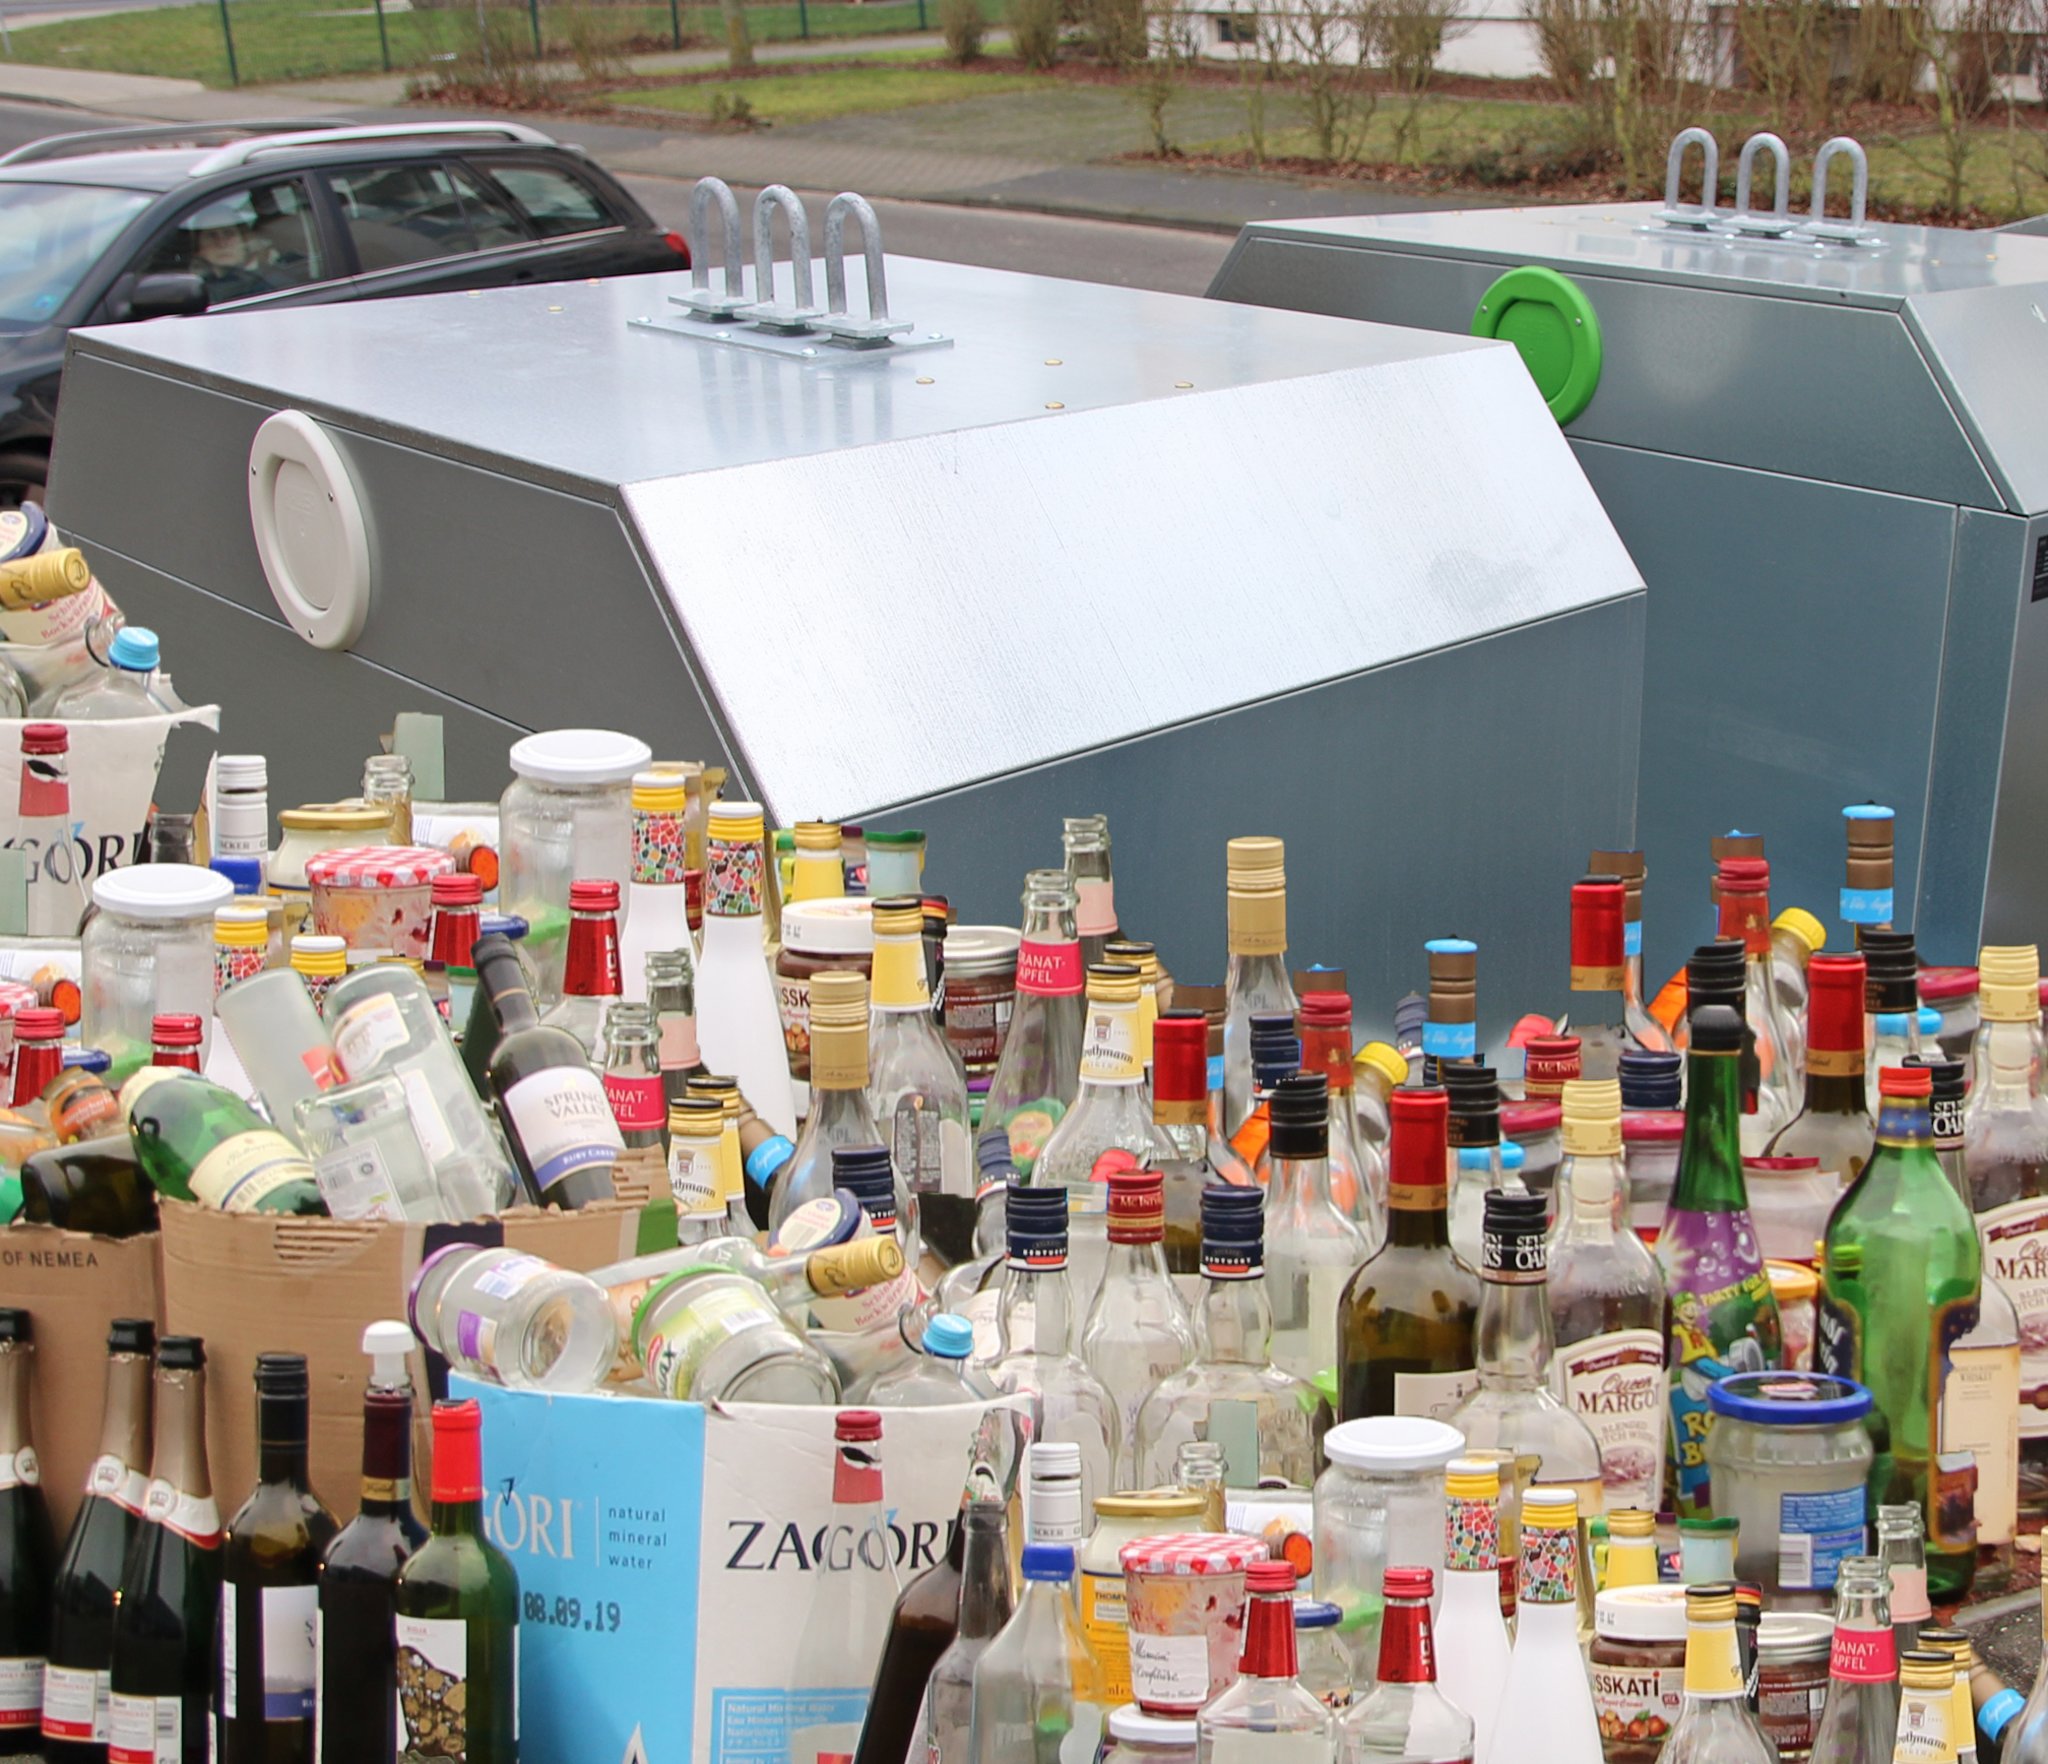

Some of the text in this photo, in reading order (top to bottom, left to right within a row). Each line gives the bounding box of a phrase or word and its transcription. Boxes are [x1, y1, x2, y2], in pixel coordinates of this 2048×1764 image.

[3, 1251, 99, 1268] OF NEMEA
[1601, 1372, 1653, 1395] Queen
[608, 1505, 667, 1523] natural
[608, 1529, 668, 1547] mineral
[608, 1553, 653, 1569] water
[1592, 1670, 1660, 1697] SSKATI
